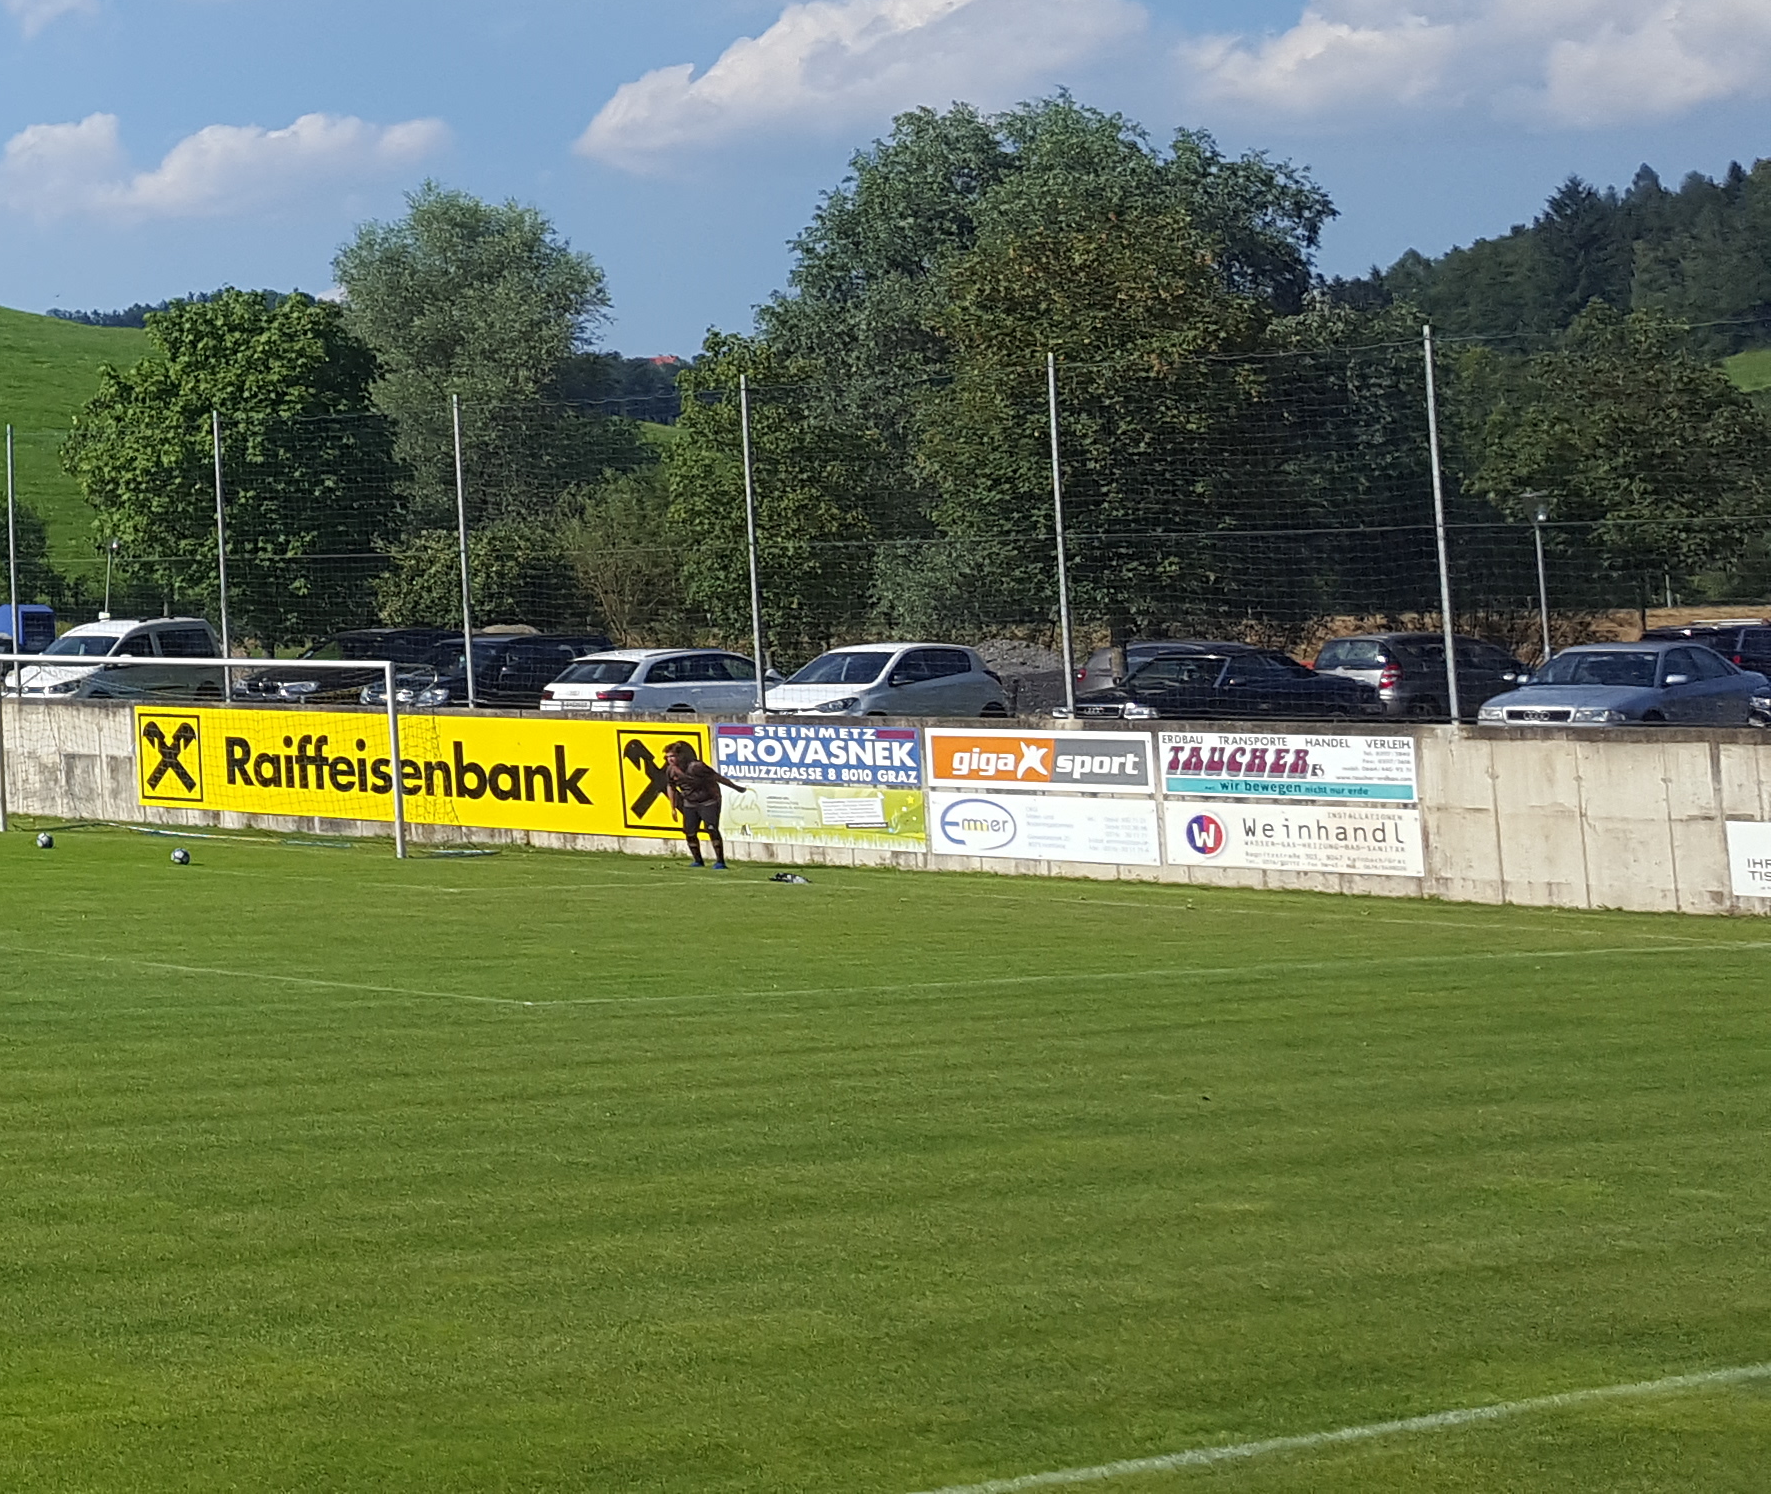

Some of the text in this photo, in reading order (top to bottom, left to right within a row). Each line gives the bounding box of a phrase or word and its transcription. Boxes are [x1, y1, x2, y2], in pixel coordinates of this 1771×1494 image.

[754, 726, 877, 740] STEINMETZ
[1162, 735, 1412, 749] ERDBAU TRANSPORTE HANDEL VERLEIH
[717, 738, 918, 768] PROVASNEK
[1166, 746, 1310, 778] TAUCHER
[225, 734, 594, 806] Raiffeisenbank
[720, 765, 918, 783] PAULUZZIGASSE 8 8010 GRAZ
[1056, 753, 1140, 779] sport
[1219, 780, 1240, 791] wir
[1245, 780, 1302, 796] bewegen
[1304, 786, 1328, 794] nicht
[1348, 787, 1369, 795] erde
[1327, 812, 1403, 821] INSTALLATIONEN
[1191, 823, 1216, 848] W
[1242, 817, 1405, 844] Weinhandl
